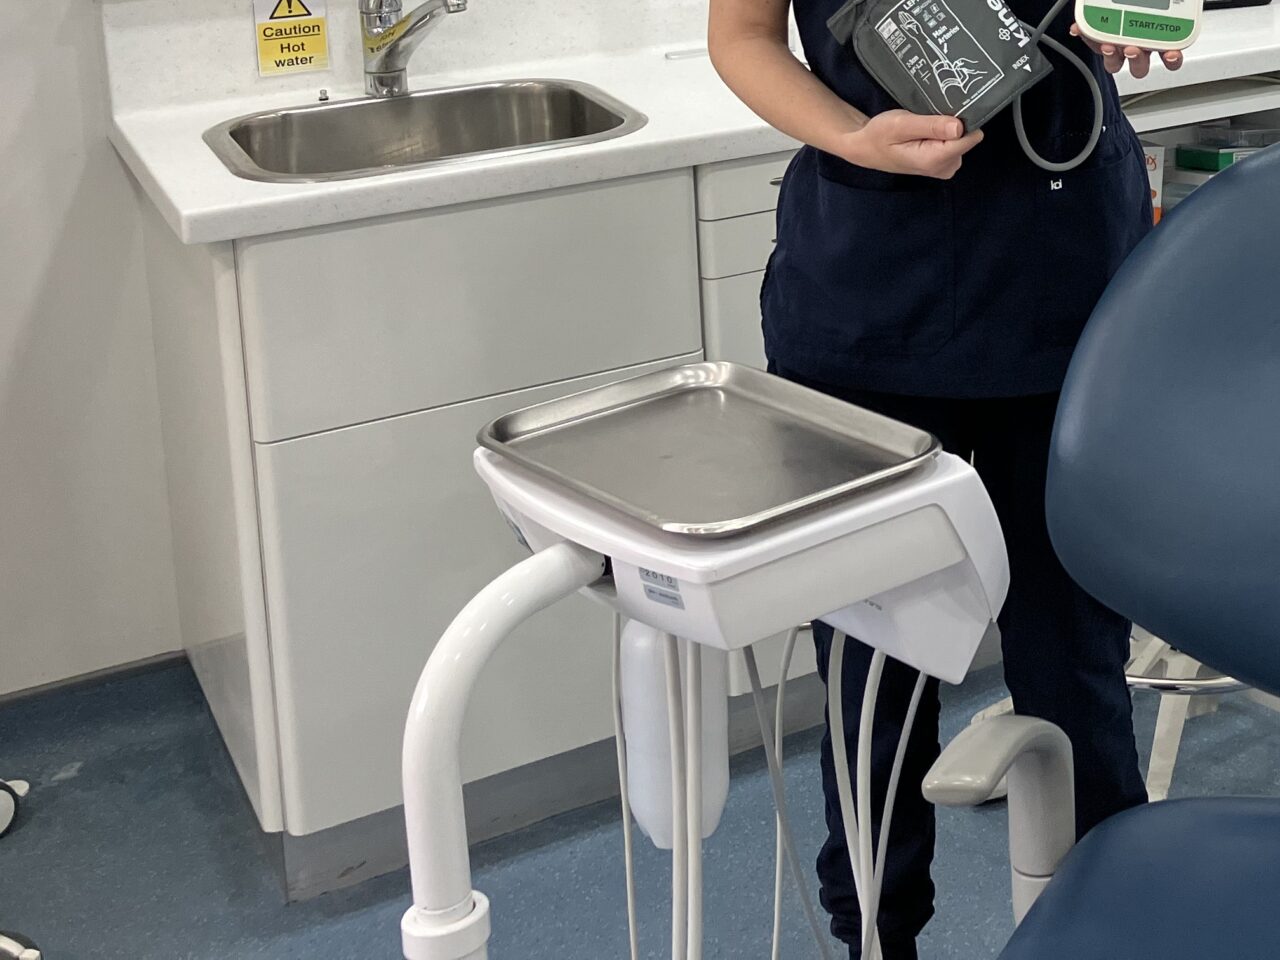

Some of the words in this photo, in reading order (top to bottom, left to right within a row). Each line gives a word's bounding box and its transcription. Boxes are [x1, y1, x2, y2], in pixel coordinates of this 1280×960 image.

[1100, 16, 1109, 24] M
[1128, 19, 1181, 33] START/STOP
[263, 24, 321, 38] Caution
[932, 25, 948, 39] Main
[938, 25, 960, 45] Arteries
[280, 41, 306, 54] Hot
[274, 55, 314, 68] water
[1011, 54, 1030, 70] INDEX
